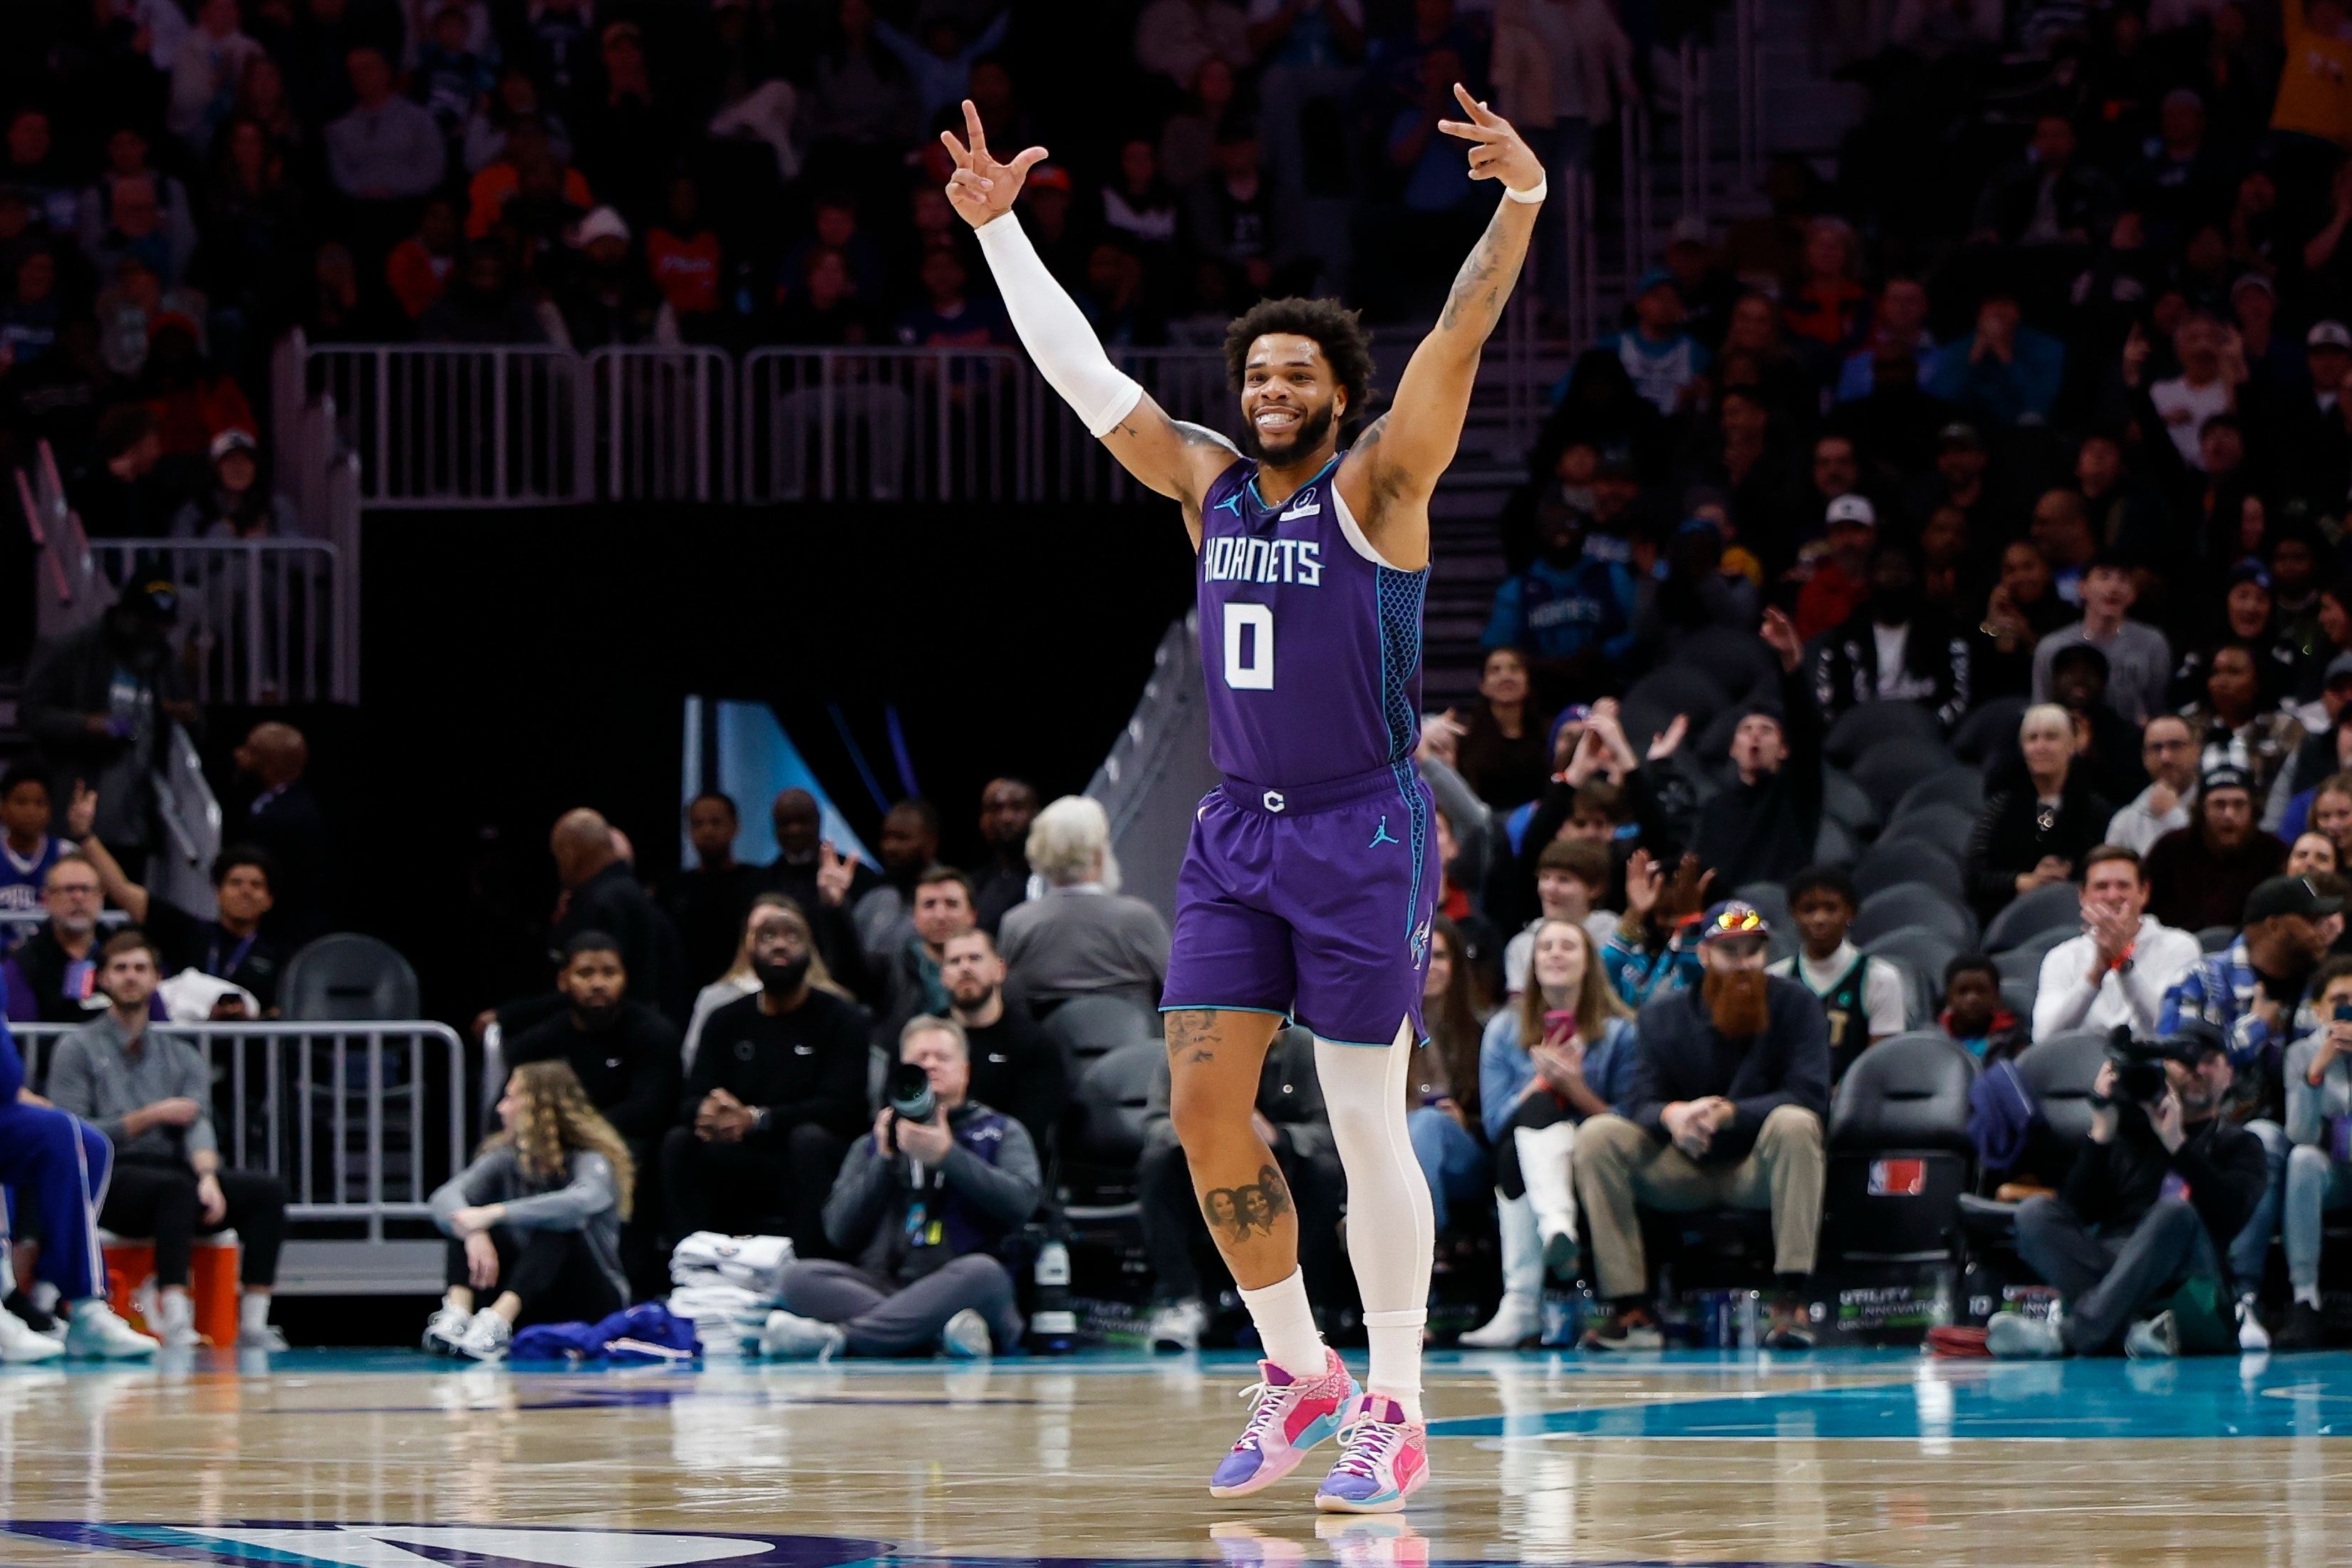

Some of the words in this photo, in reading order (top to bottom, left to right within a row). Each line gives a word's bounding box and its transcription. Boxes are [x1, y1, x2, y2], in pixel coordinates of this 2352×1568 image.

[1204, 536, 1326, 587] HORNETS
[1223, 602, 1274, 691] 0
[1840, 1286, 1911, 1307] UTILITY
